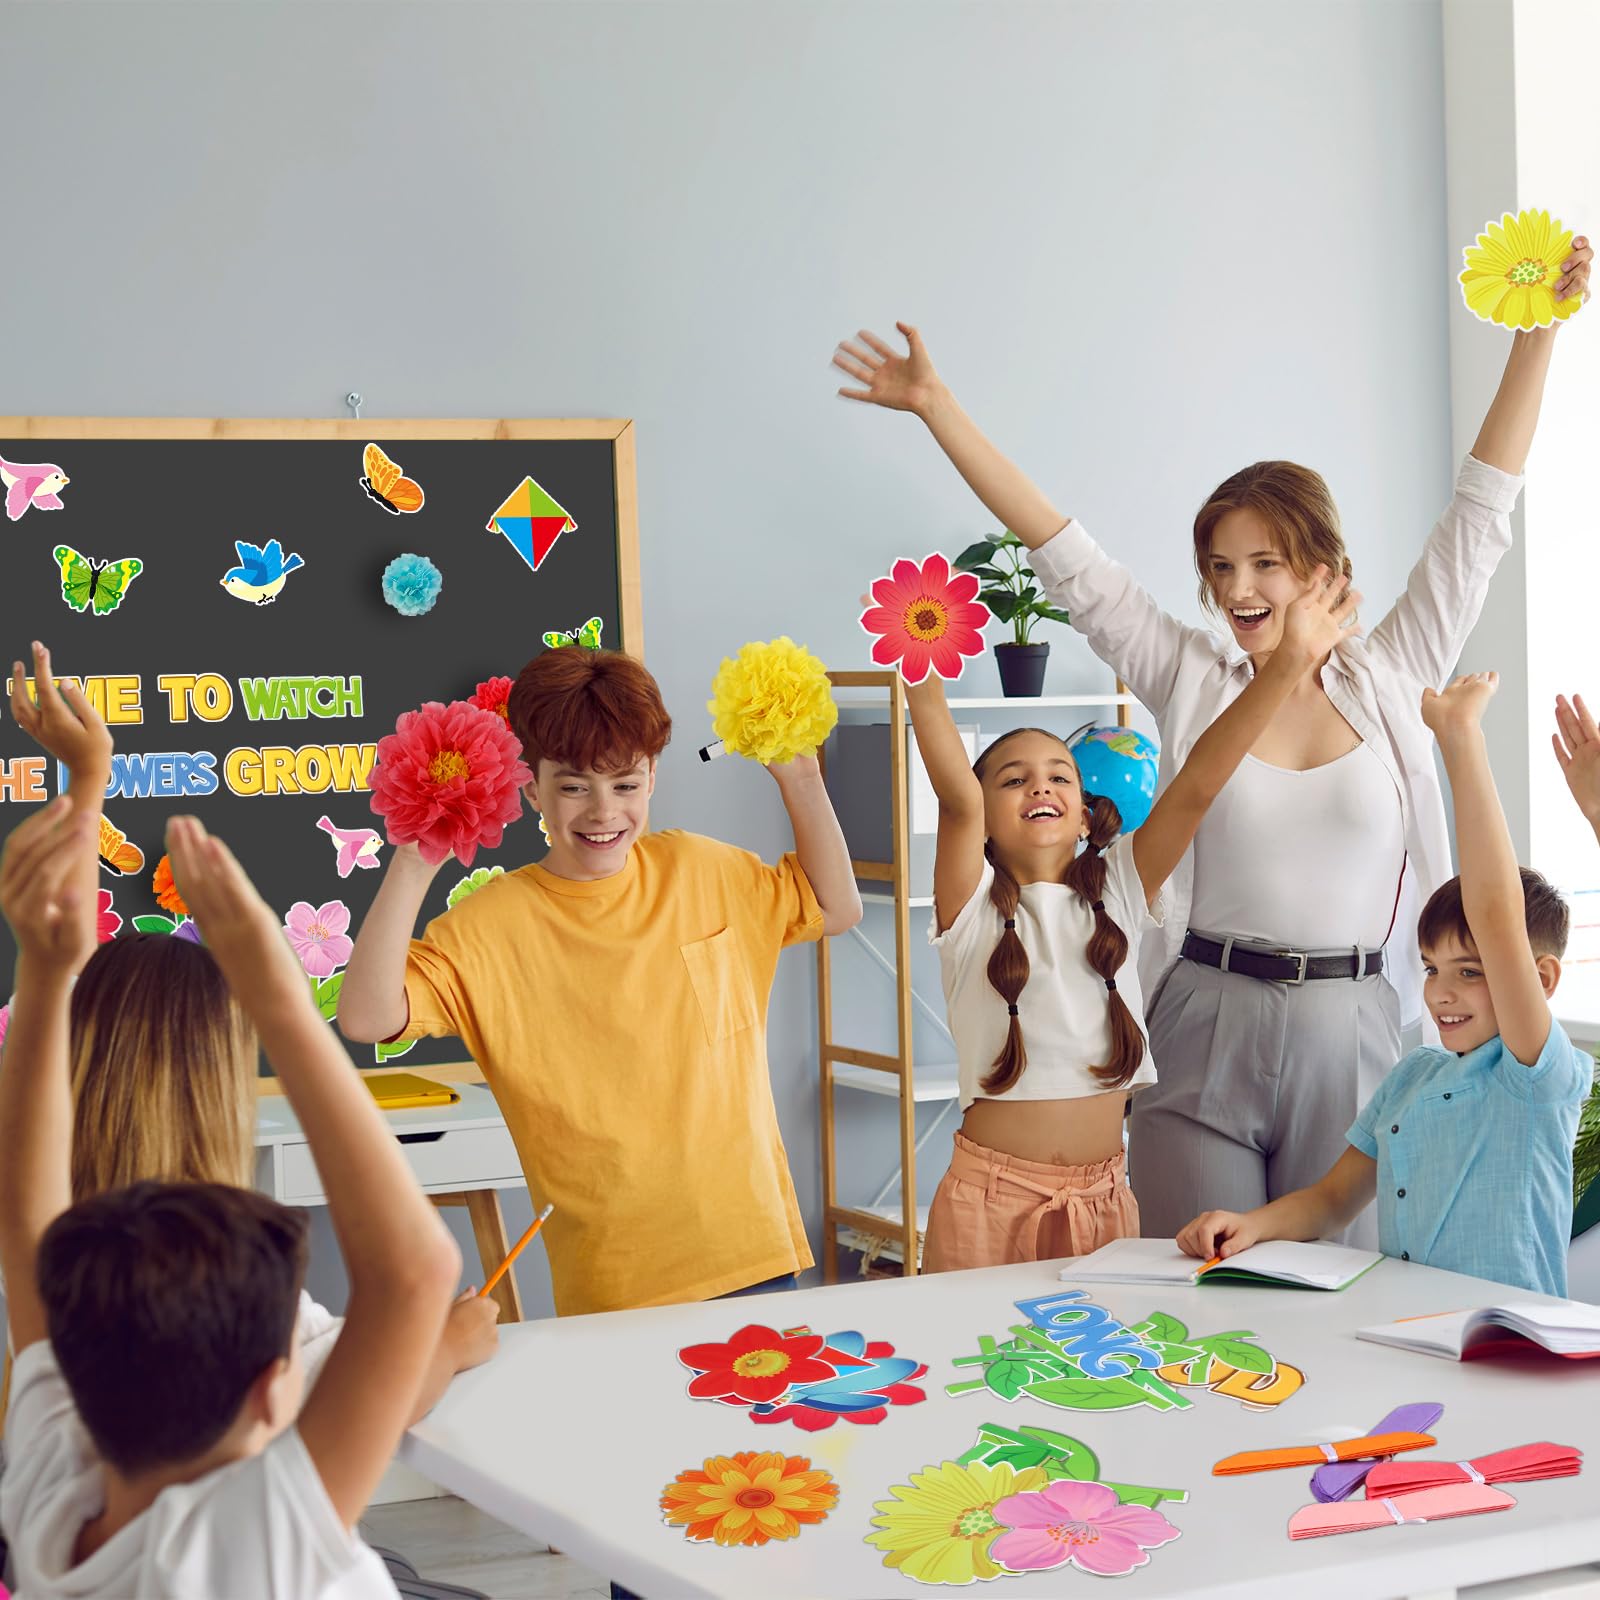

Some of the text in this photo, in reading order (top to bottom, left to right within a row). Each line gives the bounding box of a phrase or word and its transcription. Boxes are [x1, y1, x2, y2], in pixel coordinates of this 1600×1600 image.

[158, 673, 233, 724] TO
[240, 676, 363, 720] WATCH
[58, 752, 218, 799] OWERS
[225, 744, 377, 796] GROW
[1015, 1290, 1164, 1380] LONG
